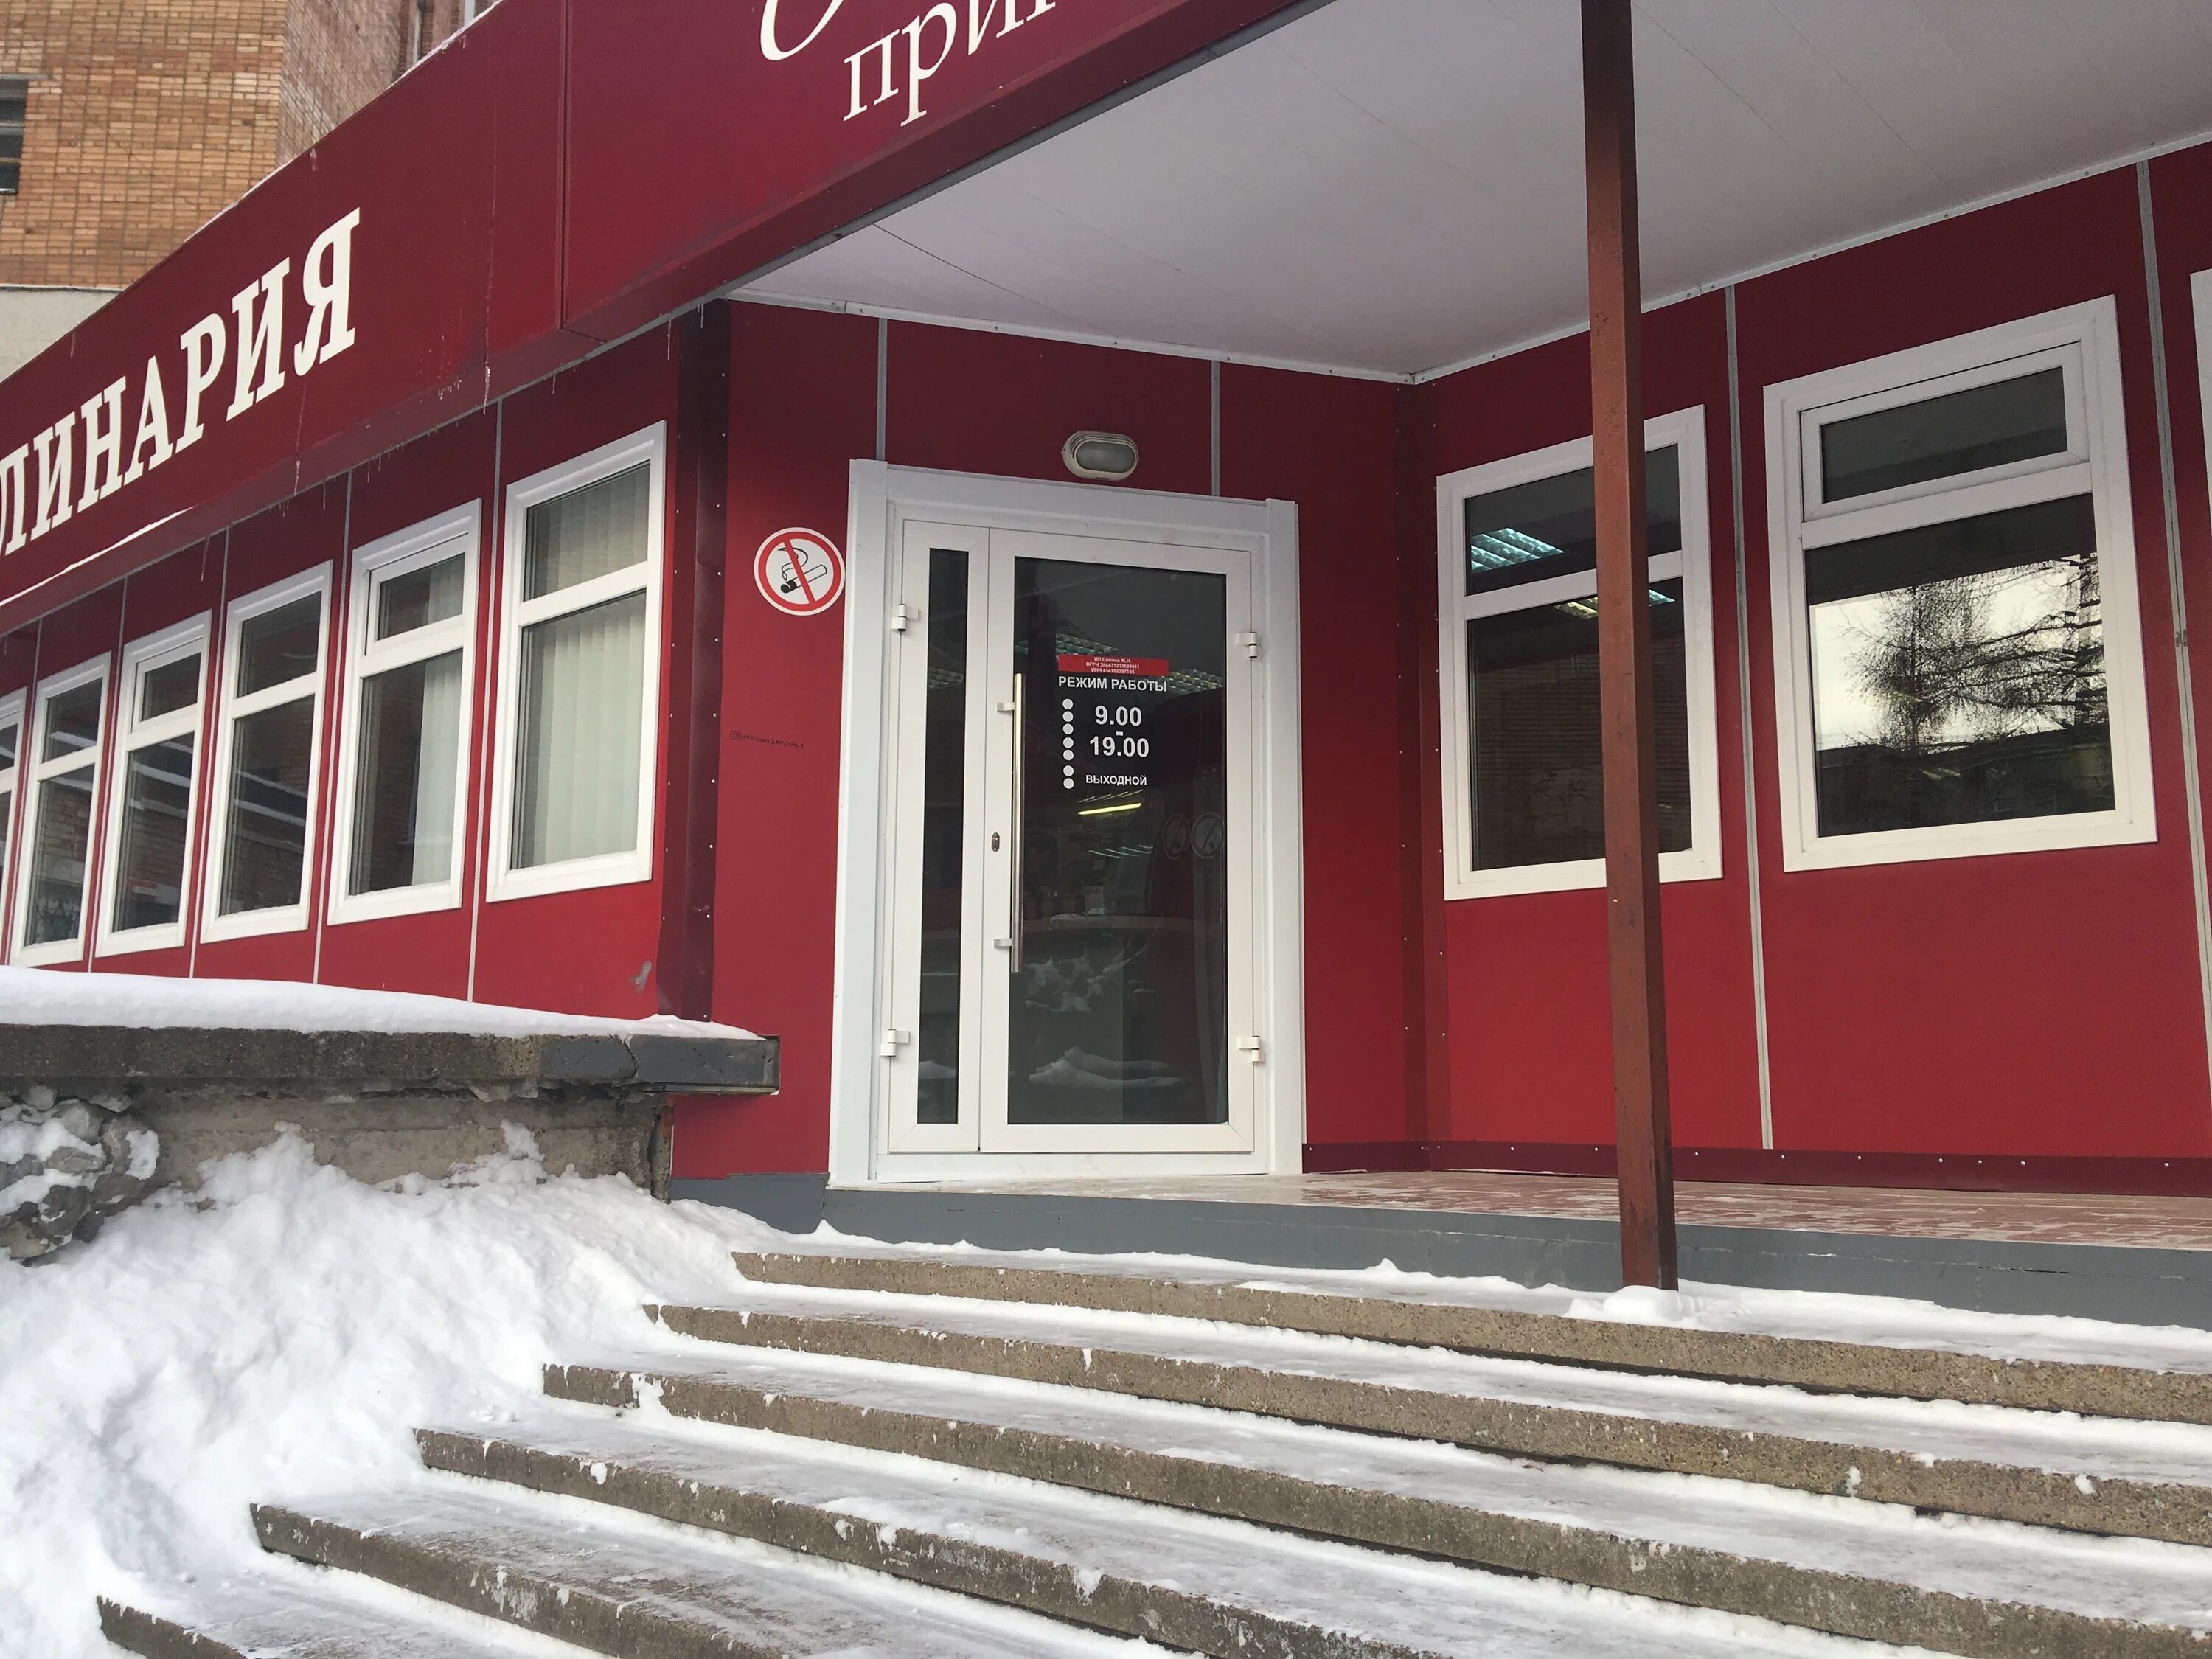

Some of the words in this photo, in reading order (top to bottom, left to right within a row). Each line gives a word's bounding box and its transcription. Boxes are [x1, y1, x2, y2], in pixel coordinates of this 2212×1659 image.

[843, 0, 1056, 127] при
[1058, 675, 1107, 689] РЕЖИМ
[1111, 678, 1167, 692] РАБОТЫ
[1095, 705, 1142, 726] 9.00
[1089, 736, 1150, 757] 19.00
[1085, 774, 1147, 787] ВЫХОДНОЙ
